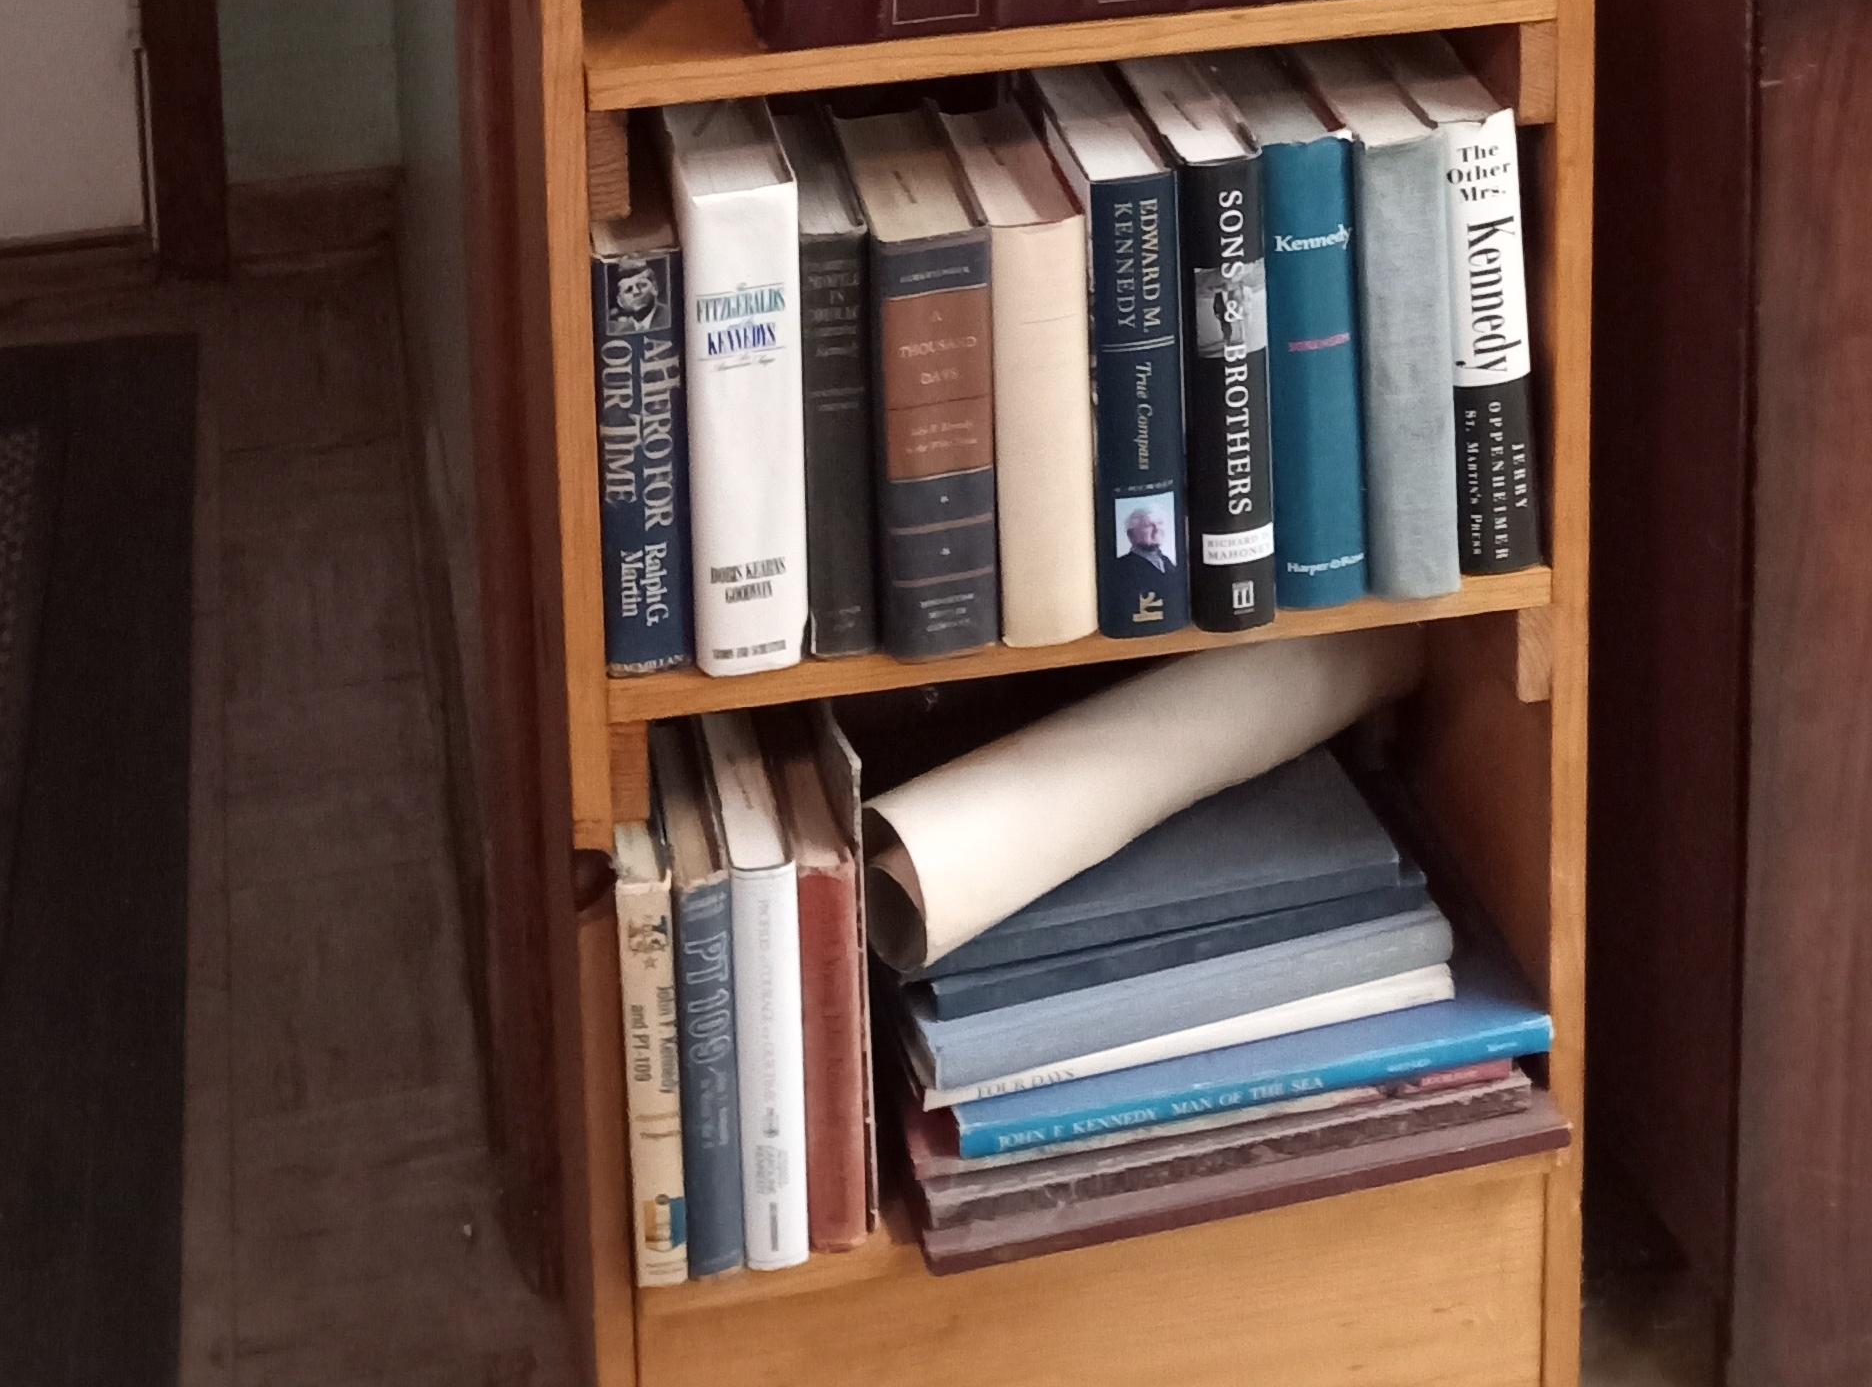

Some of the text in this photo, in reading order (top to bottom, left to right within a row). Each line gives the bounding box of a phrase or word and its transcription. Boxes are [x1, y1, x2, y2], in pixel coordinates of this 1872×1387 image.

[1457, 144, 1500, 163] The
[1446, 162, 1512, 185] Other
[1459, 186, 1507, 202] Mrs.
[1273, 224, 1353, 252] Kennedy
[1113, 202, 1136, 329] KENNEDY
[1139, 198, 1161, 333] EDWARD M.
[697, 288, 786, 324] FITZGERALDS
[1455, 215, 1522, 373] Kennedy
[707, 323, 777, 355] KENNEDYS
[899, 336, 977, 358] THOUSAND
[1218, 189, 1252, 516] SONS & BROTHERS
[921, 367, 959, 385] DAYS
[600, 339, 641, 503] OUR TIME
[640, 335, 680, 531] A HERO FOR
[1135, 362, 1153, 470] True Compass
[1488, 401, 1509, 559] OPPENHEIMER
[1511, 443, 1528, 508] JERRY
[1206, 532, 1257, 548] RICHARD
[1207, 541, 1271, 561] MAHONEY
[620, 550, 643, 617] Martin
[639, 541, 667, 603] Ralph
[710, 556, 787, 584] DORIS KEARNS
[1287, 562, 1329, 576] Harper
[725, 580, 773, 603] GOODWIN
[684, 931, 730, 985] PT
[631, 1004, 648, 1029] and
[688, 988, 732, 1064] 109
[977, 1068, 1075, 1099] FOUR DAYS
[999, 1077, 1324, 1150] JOHN KENNEDY MAN OF THE SEA
